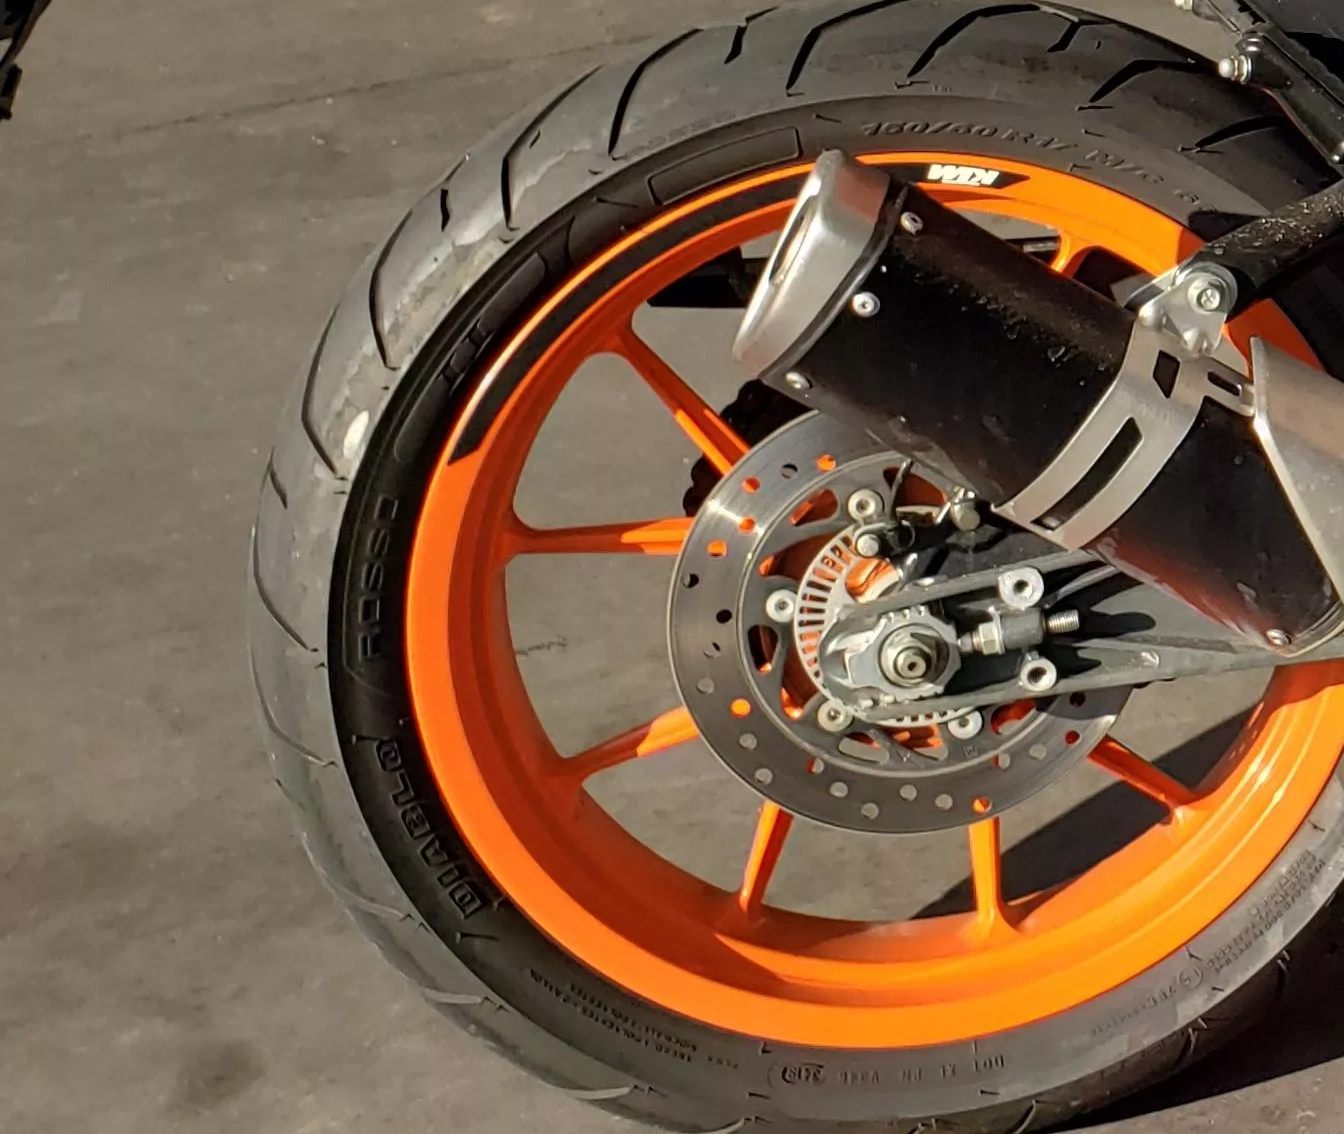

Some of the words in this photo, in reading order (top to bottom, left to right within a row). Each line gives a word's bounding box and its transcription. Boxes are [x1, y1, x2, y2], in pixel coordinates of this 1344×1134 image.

[927, 163, 1000, 187] KTM
[360, 494, 398, 664] ROSSO
[376, 737, 482, 919] DIABLO
